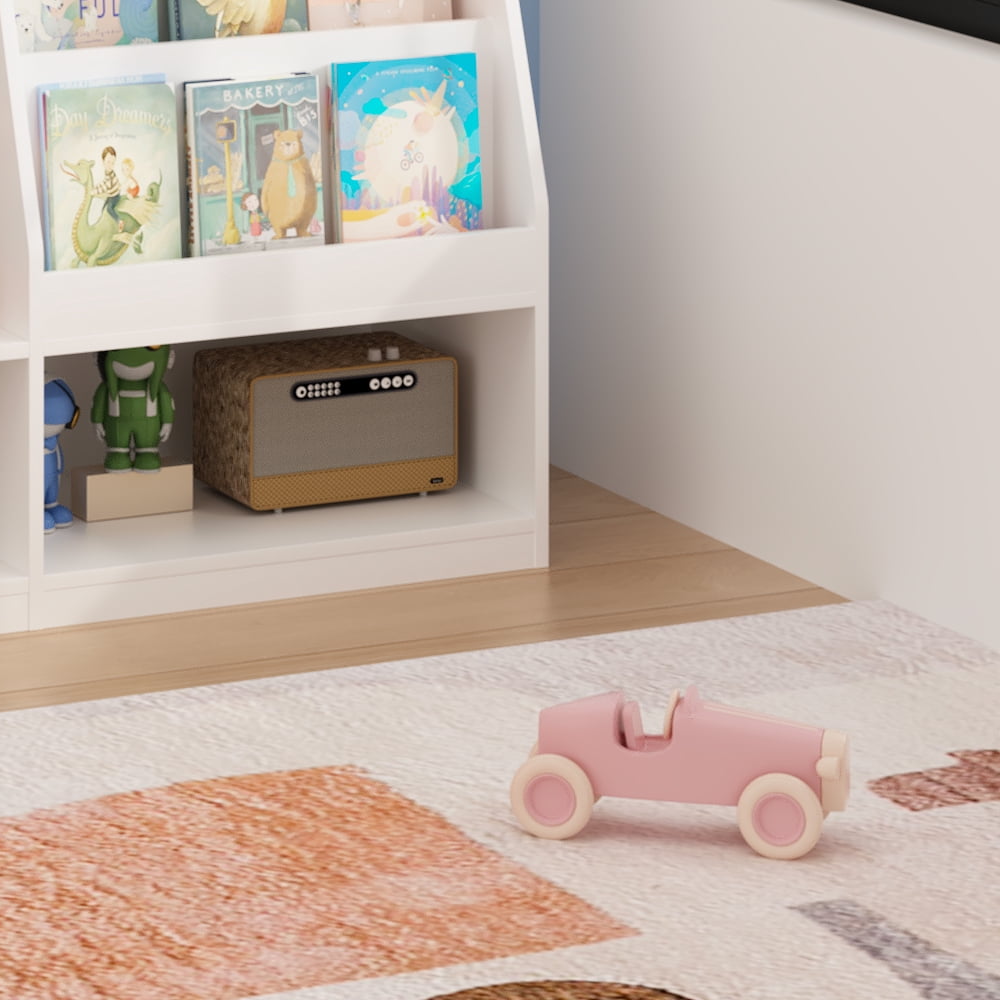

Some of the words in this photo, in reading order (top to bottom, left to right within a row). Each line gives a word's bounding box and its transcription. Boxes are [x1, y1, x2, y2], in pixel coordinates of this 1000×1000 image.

[223, 84, 284, 102] BAKERY
[50, 103, 89, 138] Day
[96, 91, 172, 136] Dreamers
